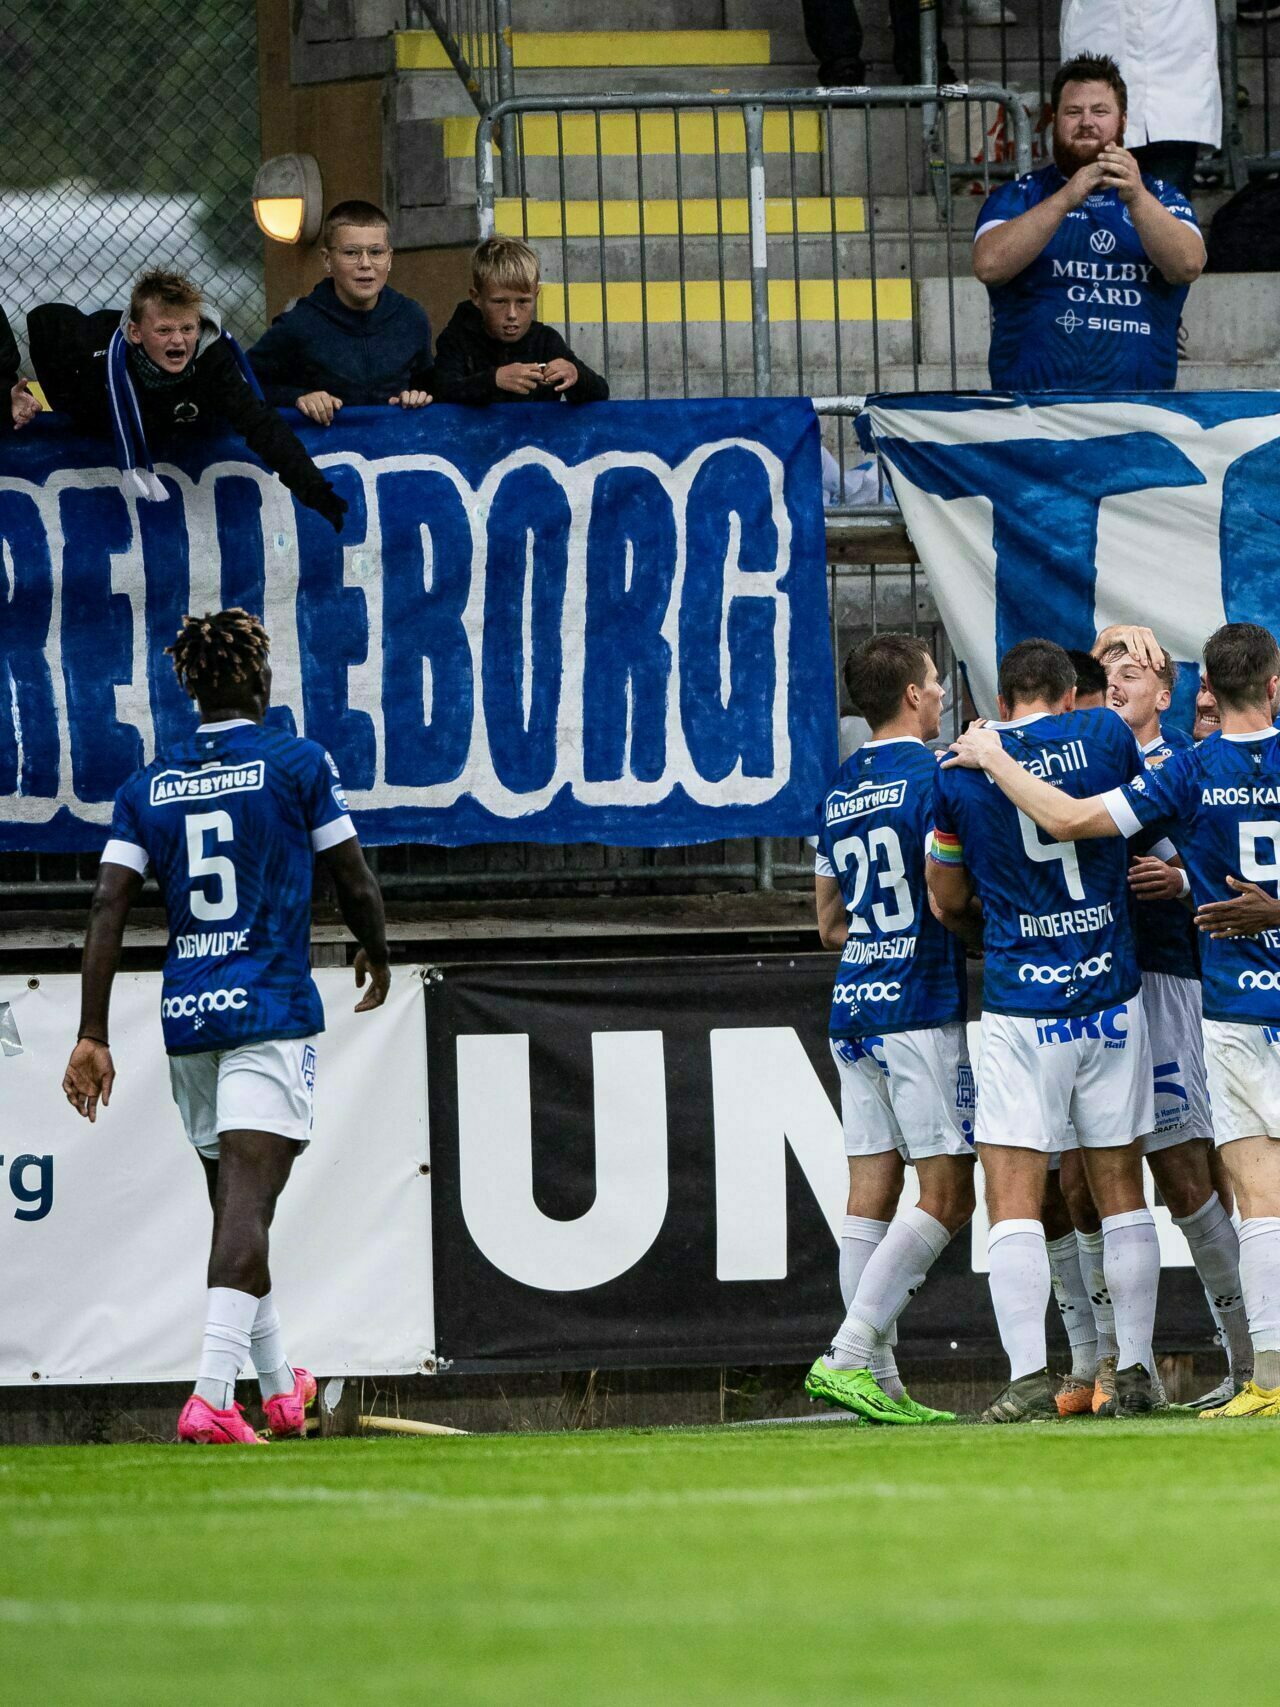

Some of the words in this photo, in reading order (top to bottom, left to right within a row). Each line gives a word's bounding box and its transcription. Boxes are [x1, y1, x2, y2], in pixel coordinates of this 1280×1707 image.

[1052, 259, 1153, 284] MELLBY
[1066, 282, 1141, 307] GÅRD
[154, 769, 259, 800] ÄLVSBYHUS
[1201, 787, 1251, 806] AROS
[828, 787, 900, 820] ÄLVSBYHUS
[184, 809, 237, 921] 5
[1017, 803, 1086, 901] 4
[832, 825, 915, 934] 23
[1019, 901, 1115, 938] ANDERSSON
[1104, 1040, 1126, 1049] Rail
